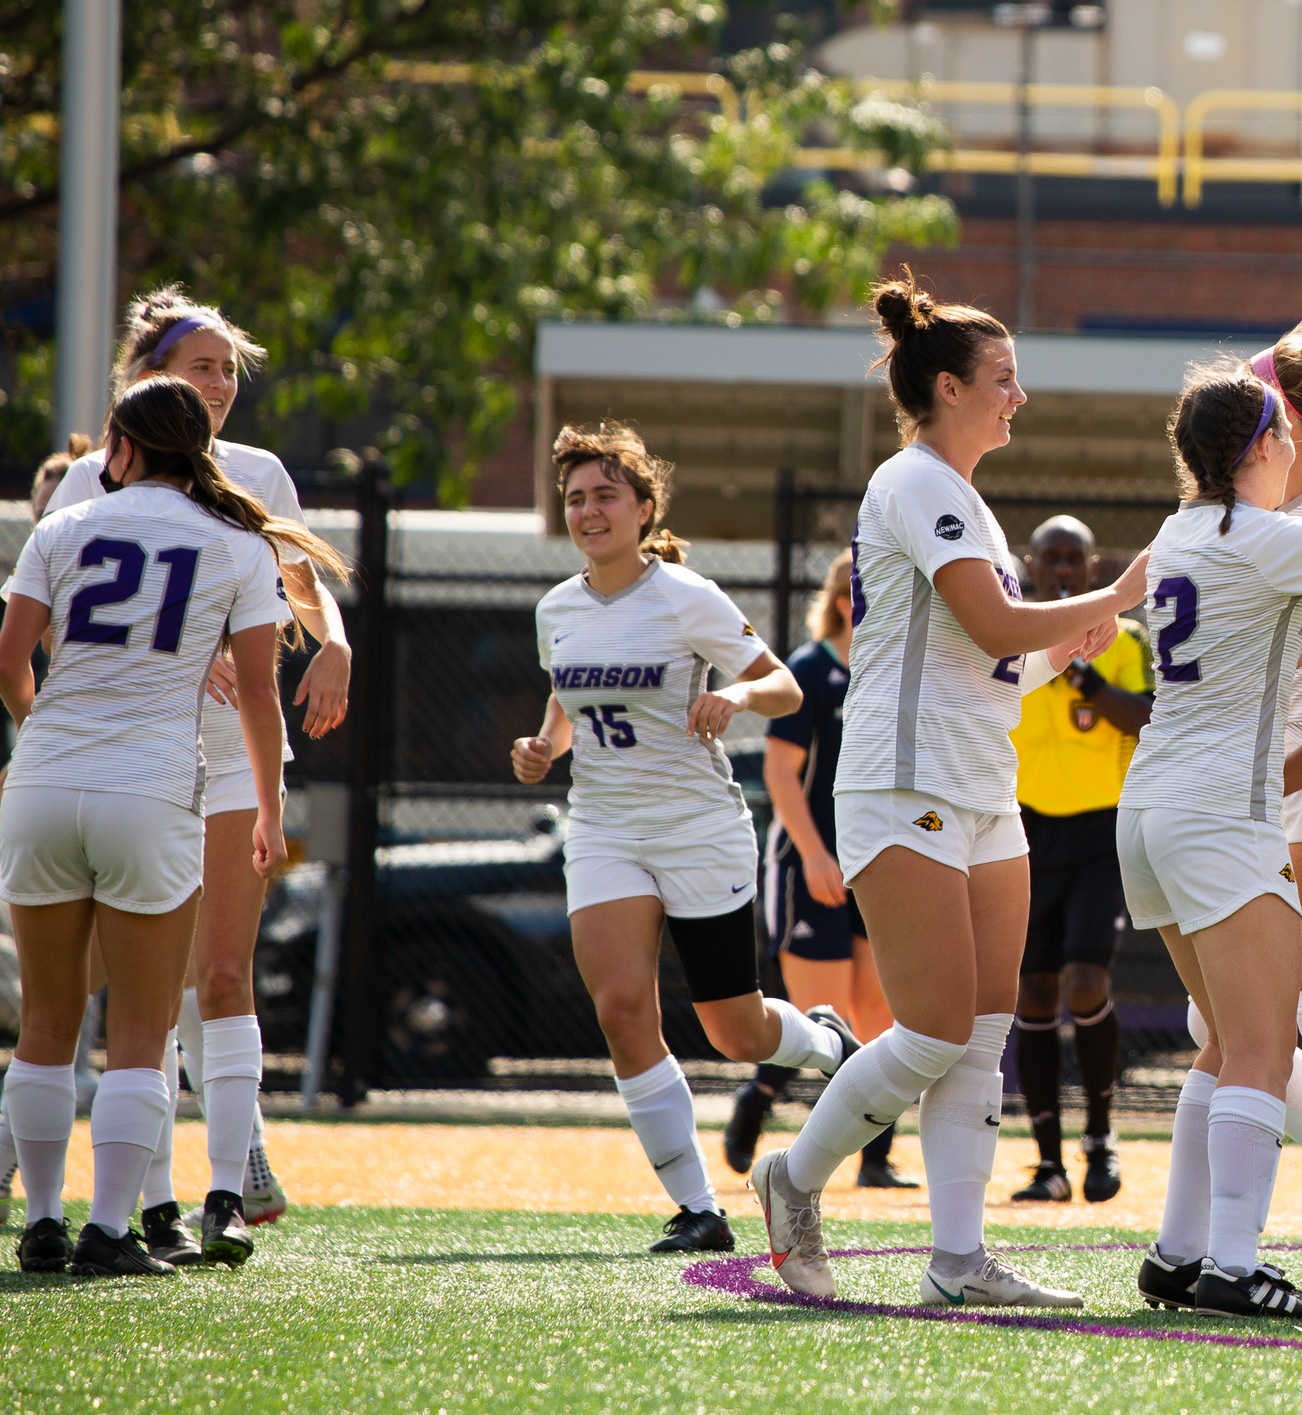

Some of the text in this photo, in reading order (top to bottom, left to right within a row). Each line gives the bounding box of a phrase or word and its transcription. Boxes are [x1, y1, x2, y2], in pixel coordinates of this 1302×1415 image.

[65, 536, 202, 656] 21
[1152, 573, 1202, 682] 2
[552, 665, 666, 690] MERSON
[578, 704, 637, 748] 15
